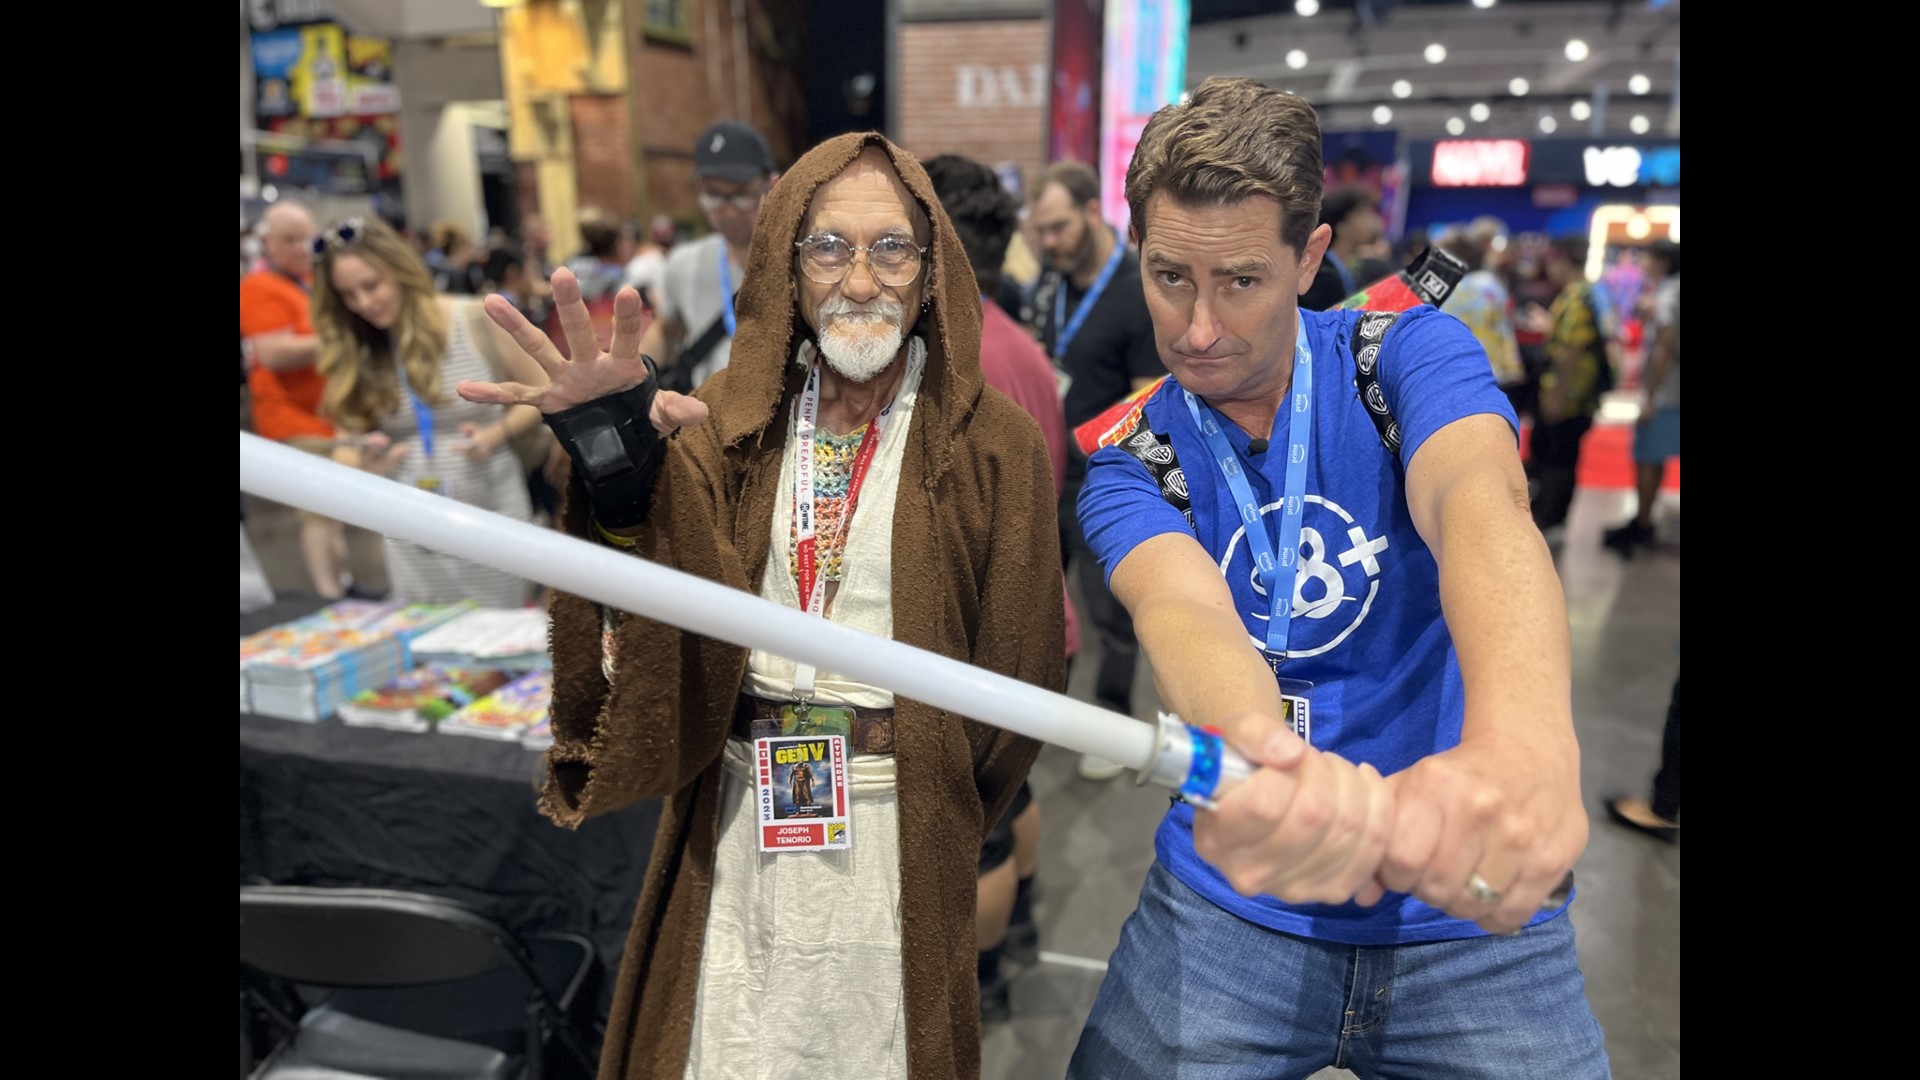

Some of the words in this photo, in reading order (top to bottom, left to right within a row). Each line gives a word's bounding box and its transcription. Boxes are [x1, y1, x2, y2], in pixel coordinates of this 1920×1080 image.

[1358, 345, 1380, 373] WB
[803, 397, 813, 429] PENNY
[800, 434, 809, 493] DREADFUL
[1147, 445, 1174, 463] WB
[1247, 503, 1258, 522] prime
[803, 544, 809, 553] NO
[1262, 551, 1274, 571] prime
[775, 747, 809, 764] GEN
[808, 741, 825, 762] V
[833, 739, 843, 787] ATTENDEE
[762, 788, 771, 821] 2023
[776, 836, 812, 845] TENORIO
[777, 826, 809, 835] JOSEPH
